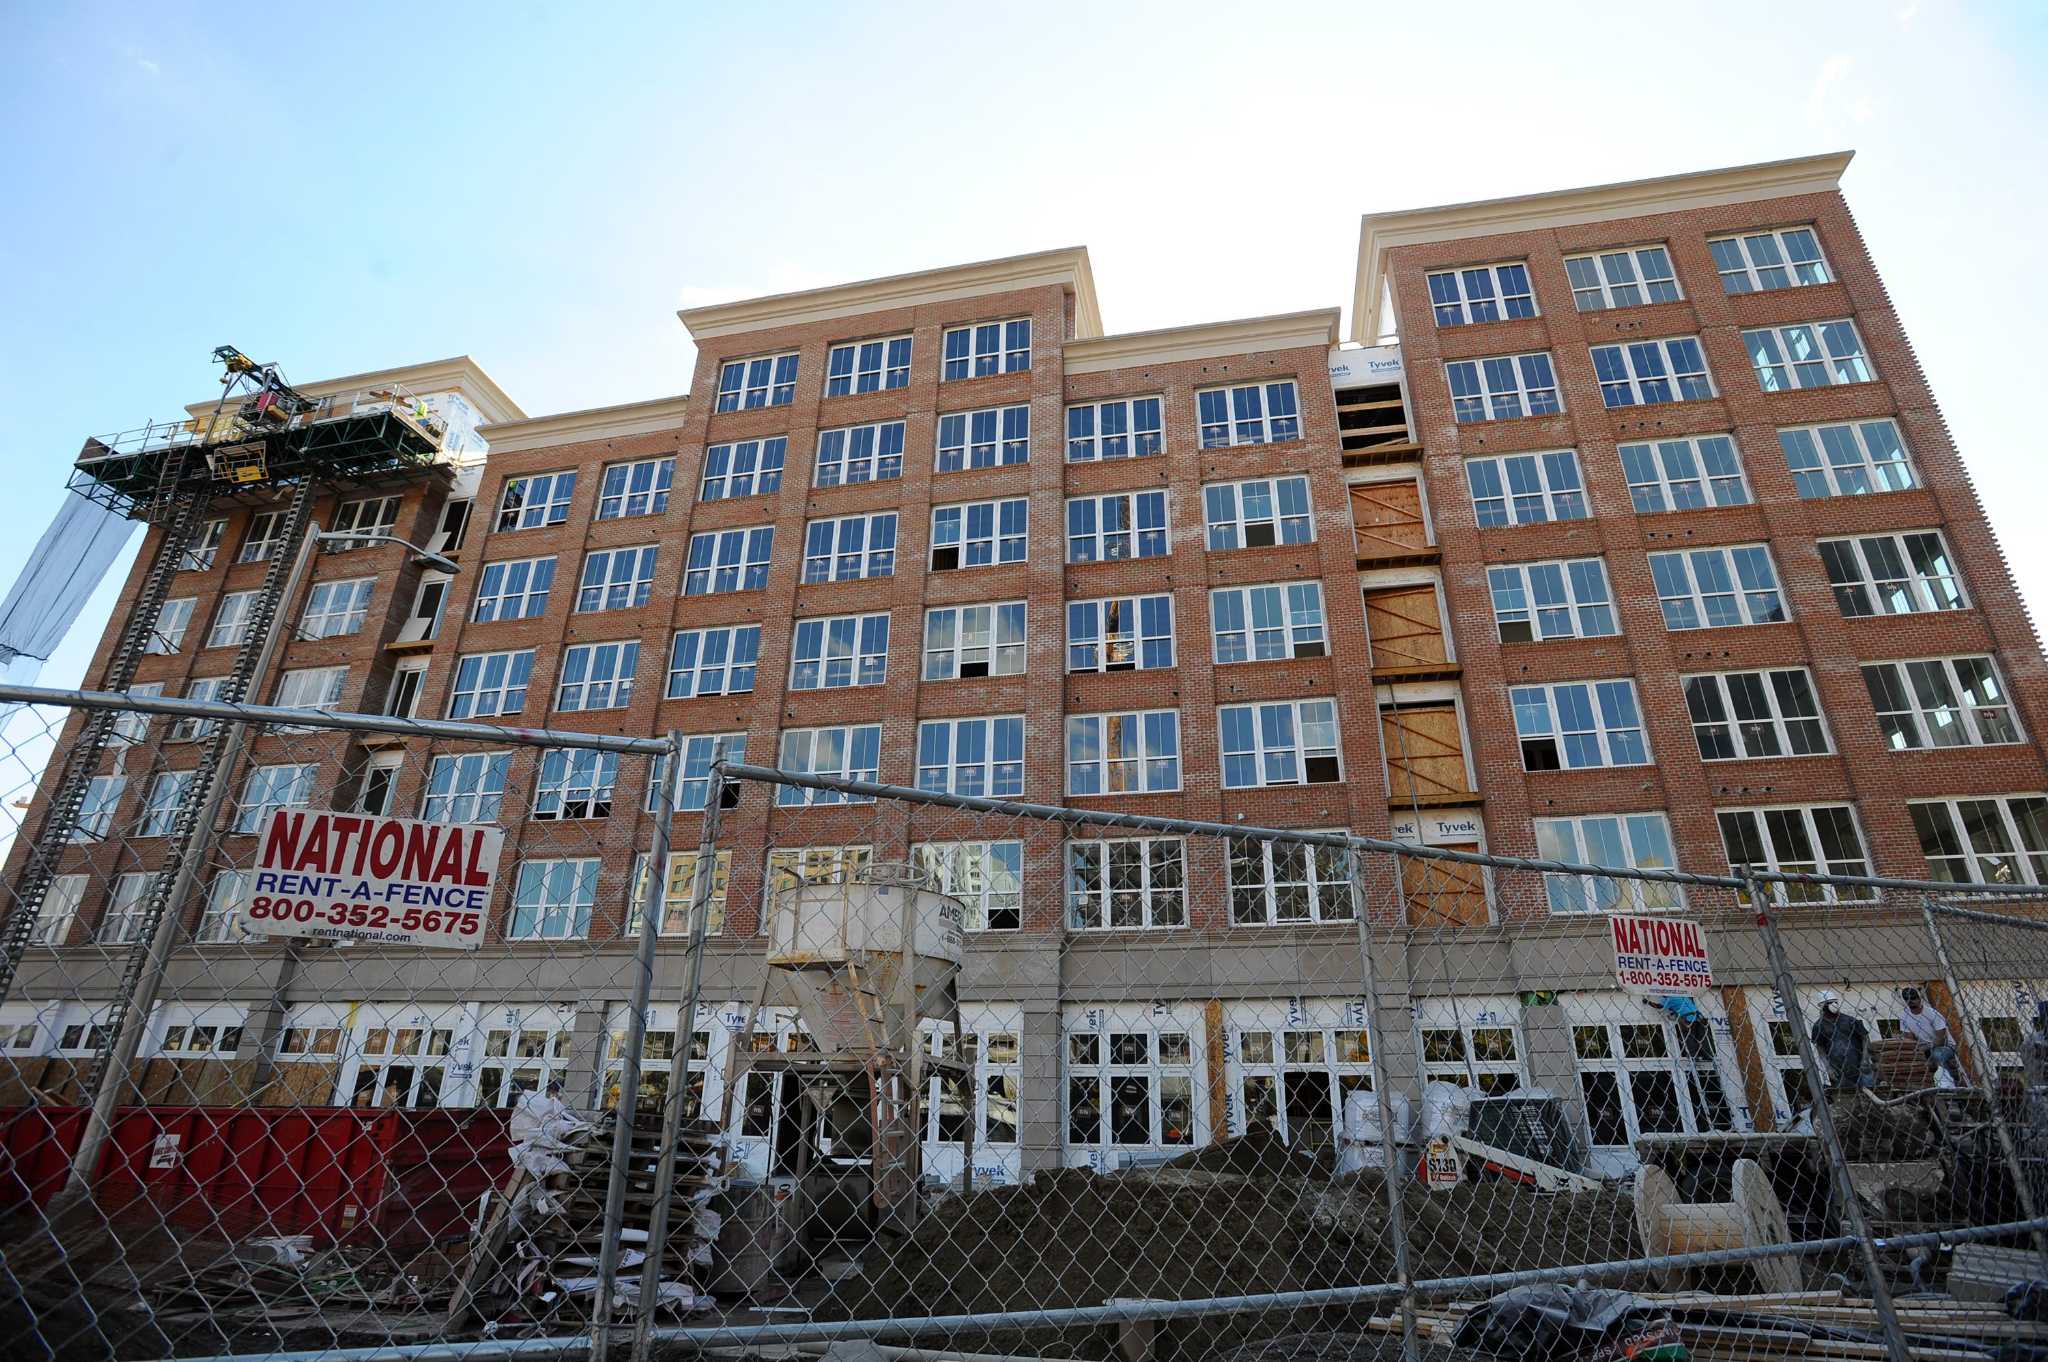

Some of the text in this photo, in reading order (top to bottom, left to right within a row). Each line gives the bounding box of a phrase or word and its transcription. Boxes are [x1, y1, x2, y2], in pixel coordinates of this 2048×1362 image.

[1368, 360, 1399, 369] Tyvek
[1436, 821, 1475, 834] Tyvek
[261, 811, 489, 887] NATIONAL
[256, 872, 486, 909] RENT-A-FENCE
[250, 896, 480, 935] 800-352-5675
[312, 927, 411, 942] rentnational.com
[1613, 918, 1705, 958] NATIONAL
[1618, 956, 1709, 973] RENT-A-FENCE
[1619, 971, 1712, 988] 1-800-352-5675
